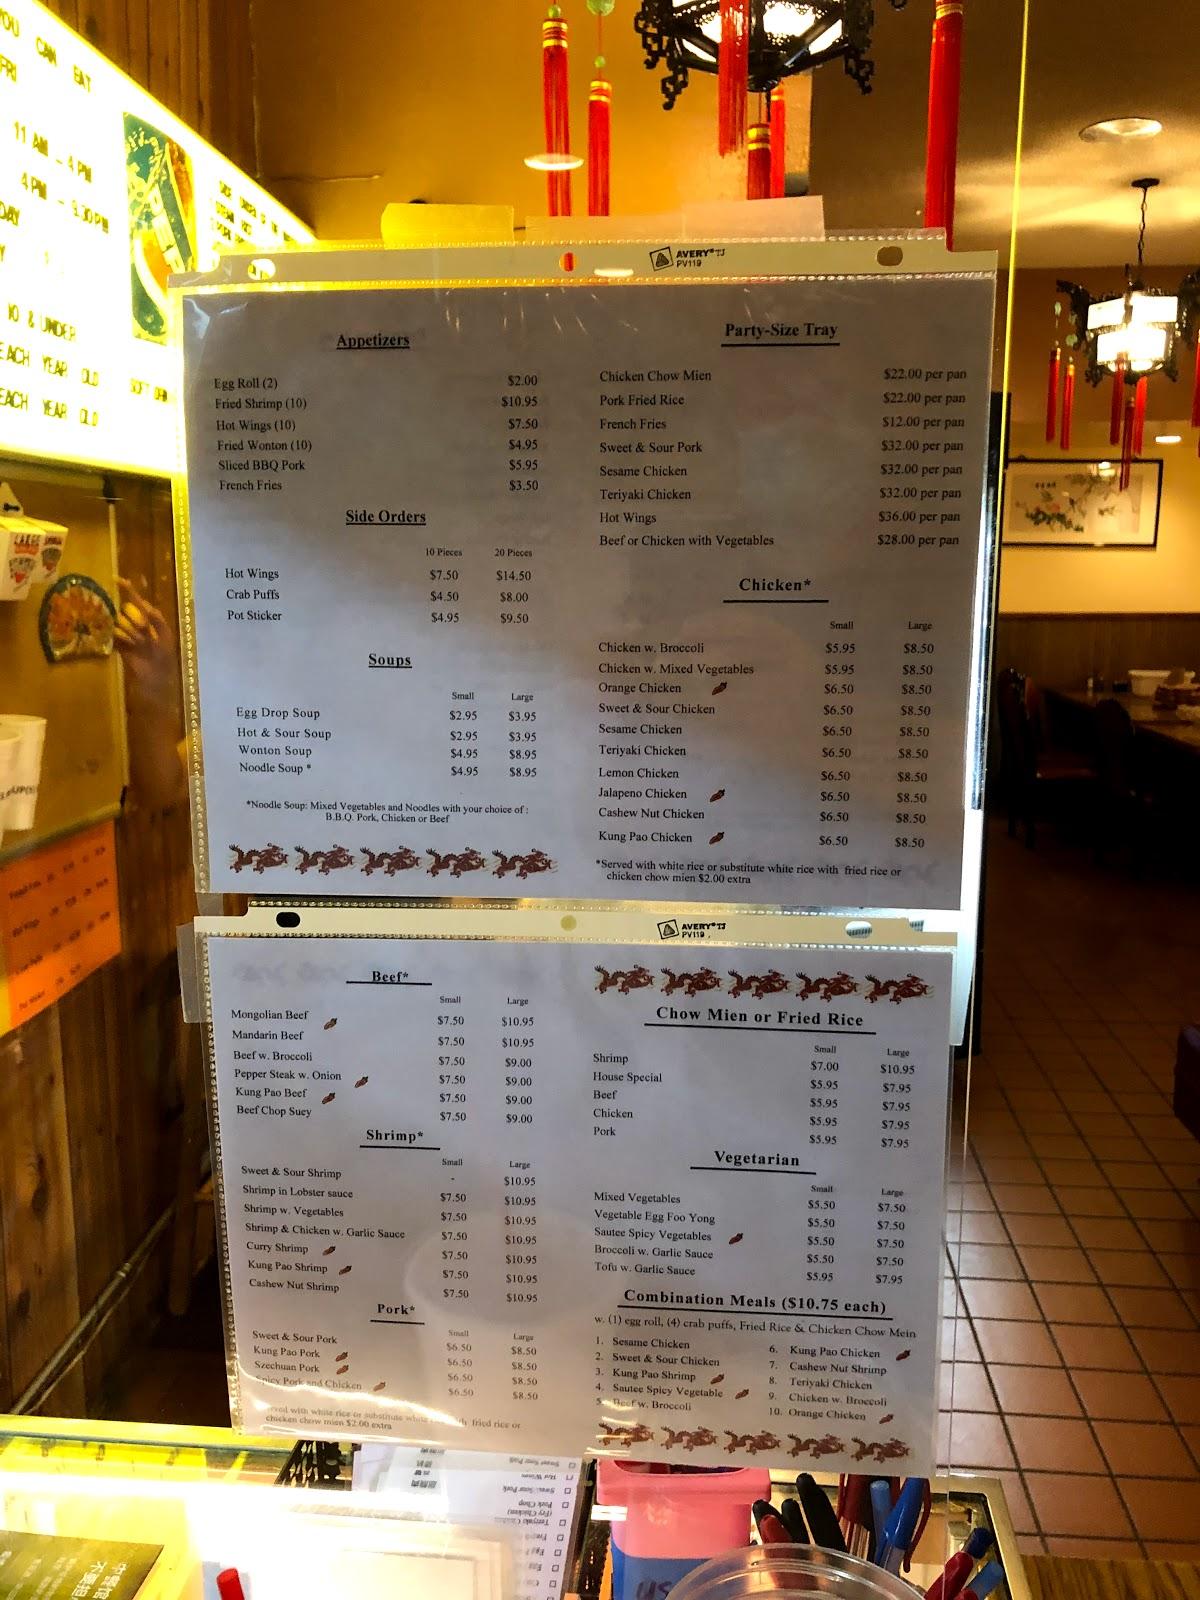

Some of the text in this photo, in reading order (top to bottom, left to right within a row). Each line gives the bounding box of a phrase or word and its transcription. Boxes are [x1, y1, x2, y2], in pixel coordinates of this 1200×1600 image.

[73, 64, 91, 93] EAT
[14, 121, 26, 144] 11
[676, 259, 702, 268] PV119
[41, 314, 76, 341] UNDER
[725, 323, 838, 340] Party-Size Tray
[336, 333, 410, 351] Appetizers
[42, 355, 67, 377] YEAR
[508, 375, 537, 386] $2.00
[600, 369, 711, 382] Chicken Chow Mien
[884, 368, 966, 382] $22.00 per pan
[214, 377, 277, 392] Egg Roll (2)
[216, 397, 306, 412] Fried Shrimp (10)
[502, 396, 537, 407] $10.95
[42, 399, 67, 420] YEAR
[346, 509, 427, 523] Side Orders
[600, 535, 774, 548] Beef or Chicken with Vegetables
[878, 534, 959, 548] $28.00 per pan
[426, 548, 462, 556] 10 Pieces
[495, 548, 532, 557] 20 Pieces
[226, 568, 279, 581] Hot Wings
[430, 569, 458, 580] $7.50
[497, 570, 531, 581] $14.50
[599, 642, 640, 652] Chicken
[660, 643, 704, 653] Broccoli
[826, 643, 855, 653] $5.95
[904, 643, 934, 654] $8.50
[368, 654, 412, 668] Soups
[452, 692, 474, 700] Small
[512, 693, 533, 703] Large
[237, 707, 320, 720] Egg Drop Soup
[450, 710, 477, 720] $2.95
[509, 711, 536, 721] $3.95
[326, 812, 450, 824] B.B.Q. Pork, Chicken or Beef
[599, 831, 692, 844] Kung Pao Chicken
[819, 836, 848, 846] $6.50
[895, 837, 924, 848] $8.50
[682, 930, 705, 938] PV119
[232, 1009, 309, 1021] Mongolian Beef
[438, 1015, 464, 1026] $7.50
[657, 1006, 863, 1026] Chow Mien or Fried Rice
[502, 1016, 533, 1028] $10.95
[814, 1045, 836, 1054] Small
[887, 1048, 909, 1058] Large
[593, 1053, 628, 1065] Shrimp
[811, 1061, 839, 1072] $7.00
[880, 1064, 914, 1075] $10.95
[235, 1069, 267, 1081] Pepper
[270, 1070, 295, 1080] Steak
[312, 1071, 341, 1080] Onion
[439, 1074, 465, 1085] $7.50
[506, 1076, 532, 1087] $9.00
[714, 1150, 800, 1167] Vegetarian
[243, 1185, 353, 1198] Shrimp in Lobster sauce
[440, 1193, 466, 1203] $7.50
[505, 1196, 536, 1207] $10.95
[595, 1209, 715, 1225] Vegetable Egg Foo Yong
[808, 1218, 835, 1228] $5.50
[877, 1220, 905, 1231] $7.50
[624, 1289, 887, 1315] Combination Meals ($10.75 each)
[609, 1313, 621, 1326] (1)
[625, 1318, 640, 1327] egg
[645, 1316, 663, 1327] roll,
[667, 1317, 680, 1328] (4)
[683, 1317, 704, 1328] crab
[708, 1319, 736, 1332] puffs,
[740, 1320, 765, 1332] Fried
[770, 1321, 791, 1333] Rice
[794, 1321, 805, 1334] &
[809, 1323, 851, 1335] Chicken
[855, 1325, 885, 1336] Chow
[890, 1327, 916, 1338] Mein
[613, 1337, 648, 1347] Sesame
[651, 1338, 689, 1349] Chicken
[790, 1345, 816, 1358] Kung
[820, 1346, 837, 1357] Pao
[840, 1347, 880, 1359] Chicken
